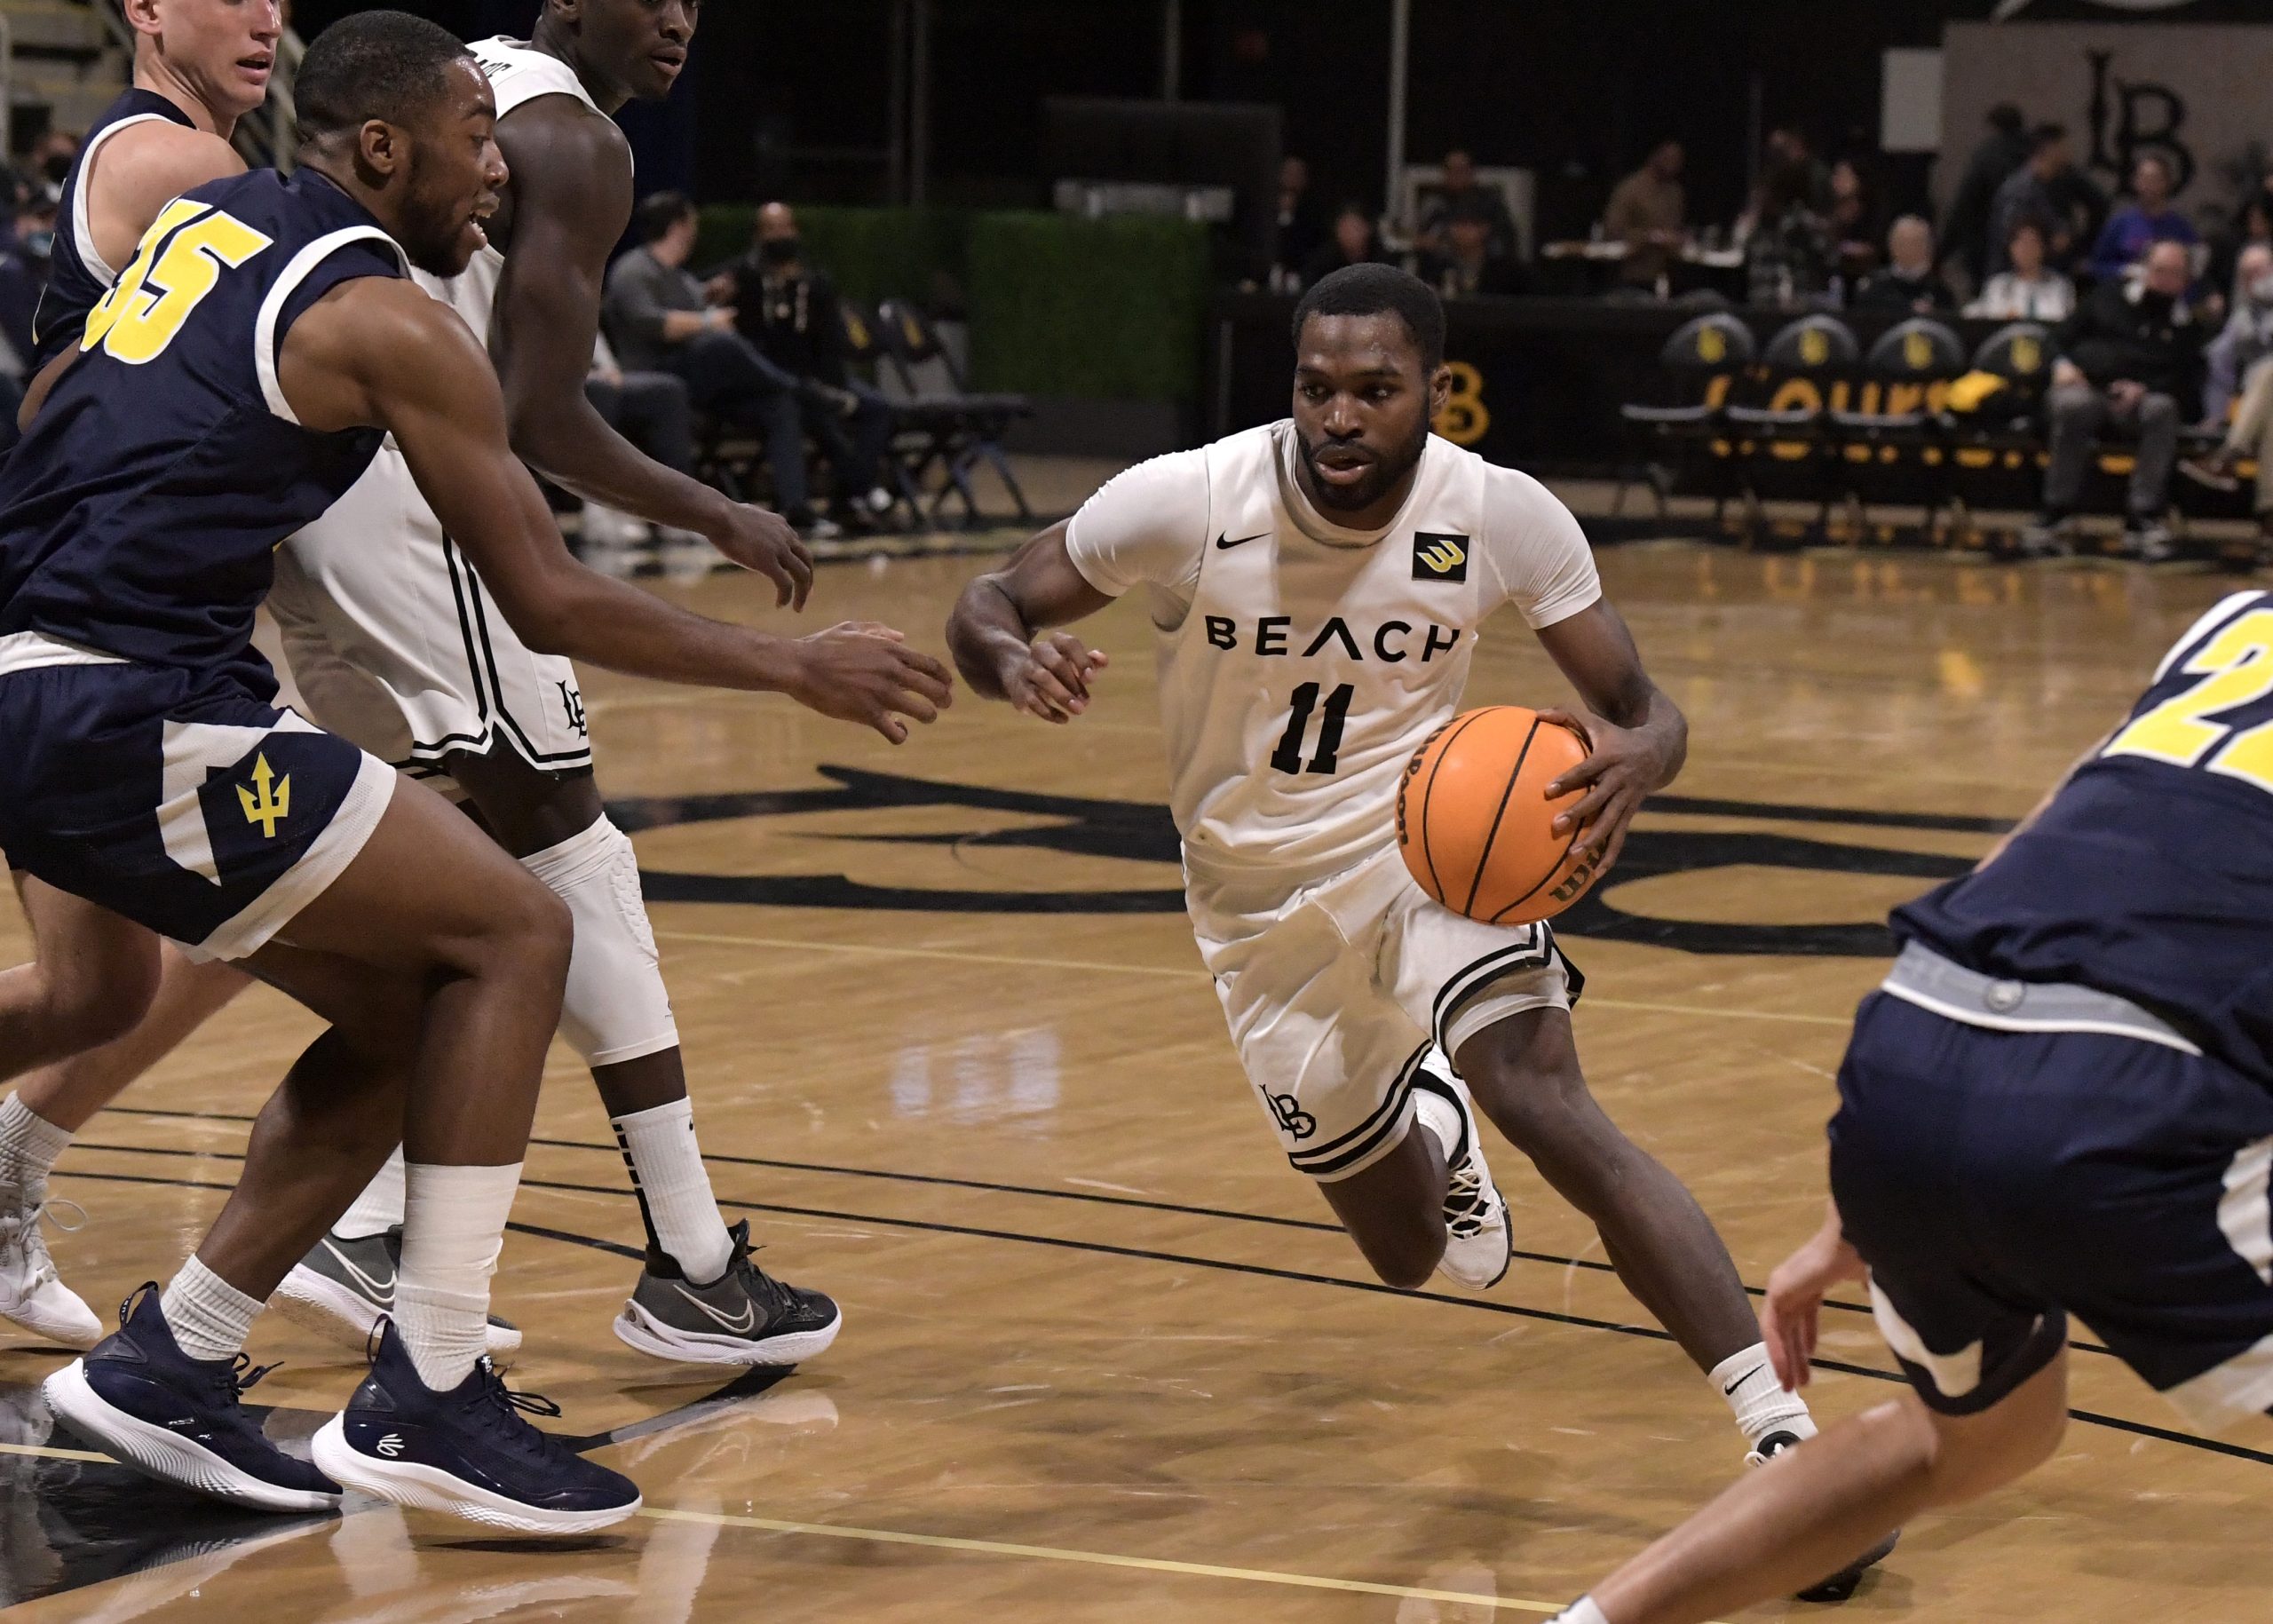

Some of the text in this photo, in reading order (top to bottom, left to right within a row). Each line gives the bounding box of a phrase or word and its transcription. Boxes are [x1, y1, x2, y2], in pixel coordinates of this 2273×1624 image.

[1205, 614, 1461, 663] BEACH
[1271, 681, 1355, 775] 11
[2101, 607, 2273, 796] 2
